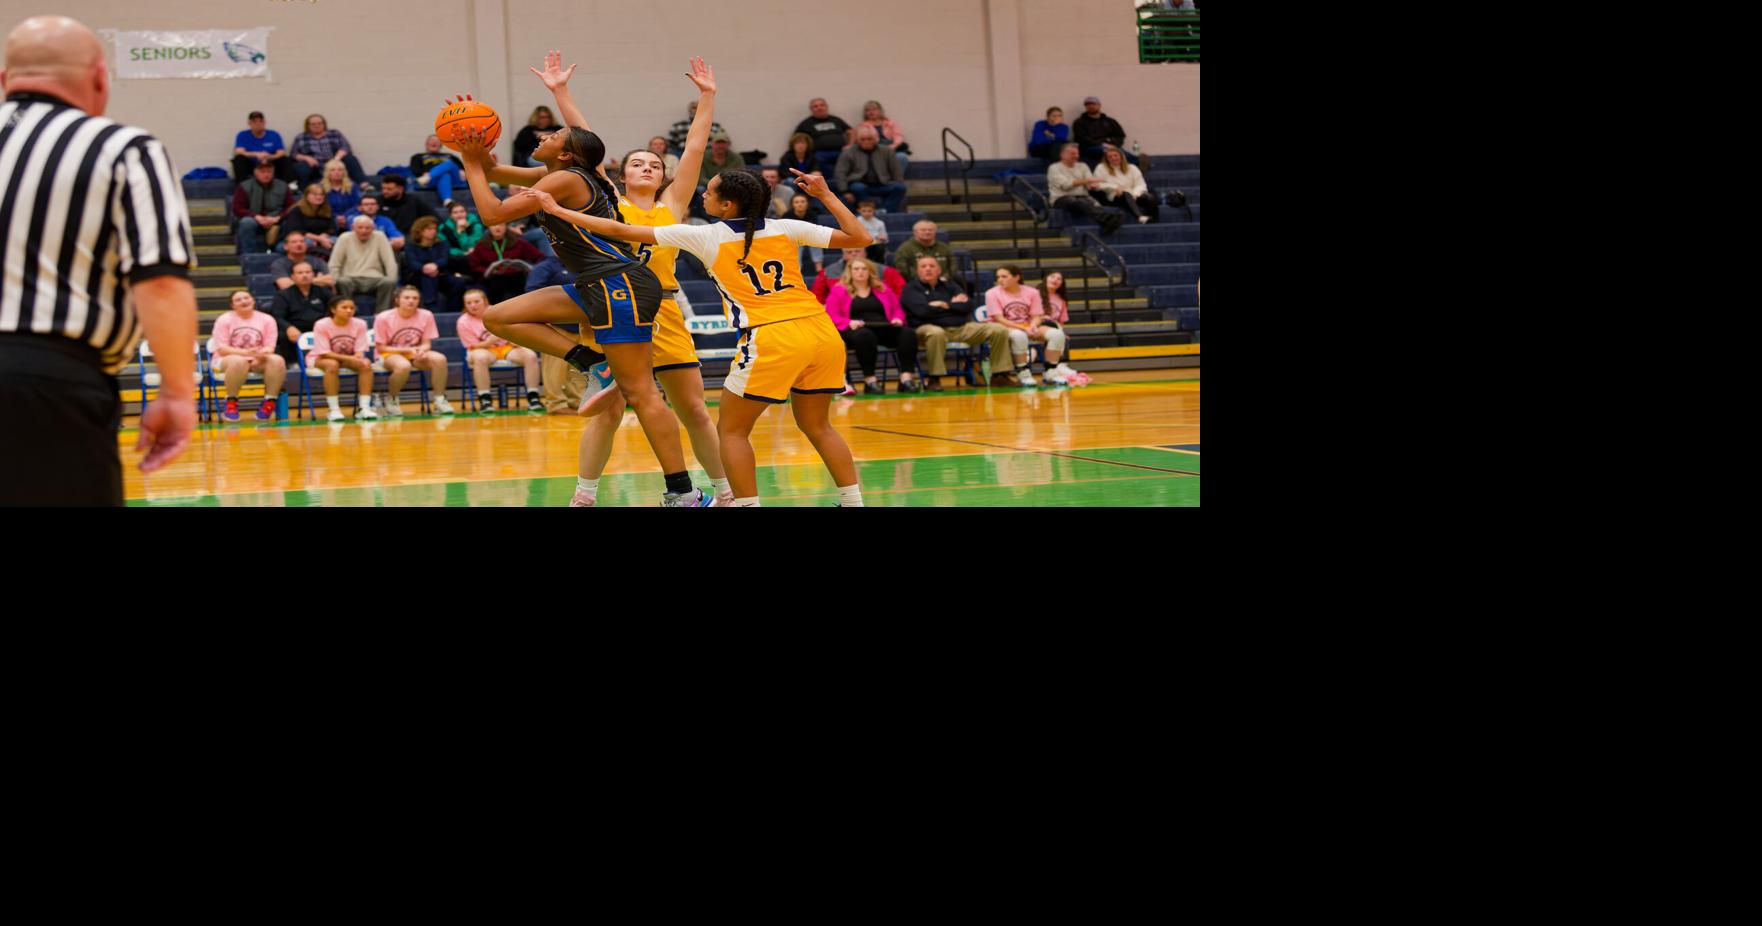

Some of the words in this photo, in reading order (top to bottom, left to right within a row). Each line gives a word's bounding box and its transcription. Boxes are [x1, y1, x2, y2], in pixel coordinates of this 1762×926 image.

[130, 47, 212, 61] SENIORS
[636, 242, 653, 266] 5
[741, 260, 795, 296] 12
[611, 289, 627, 300] G
[690, 320, 729, 329] BYRD
